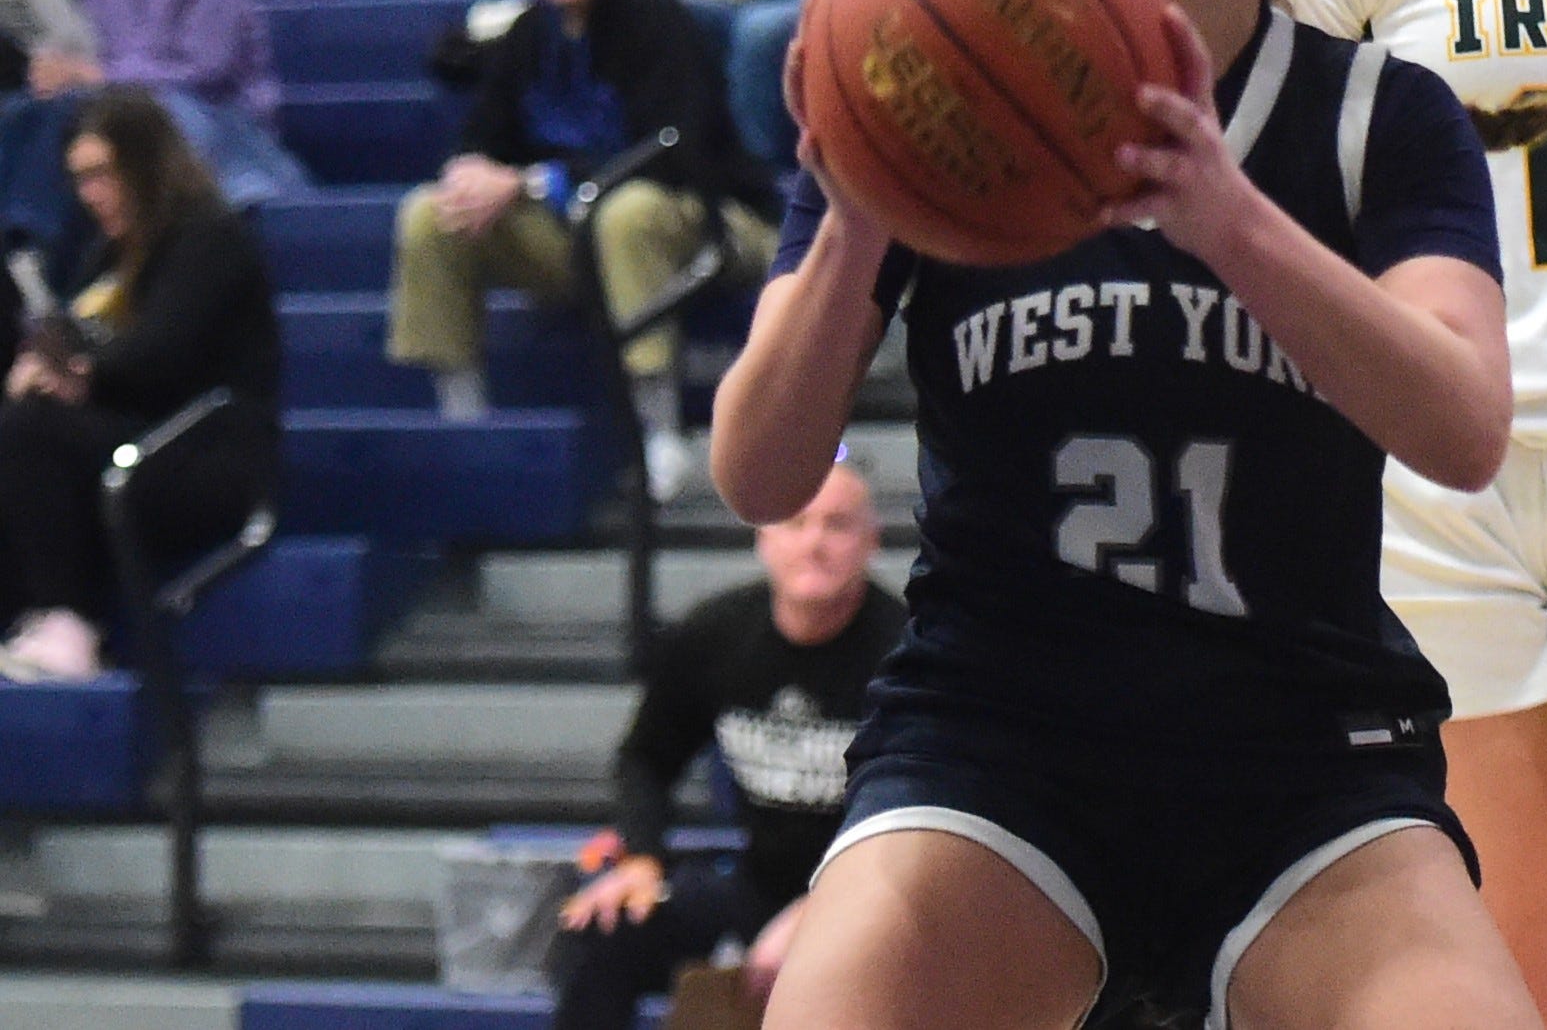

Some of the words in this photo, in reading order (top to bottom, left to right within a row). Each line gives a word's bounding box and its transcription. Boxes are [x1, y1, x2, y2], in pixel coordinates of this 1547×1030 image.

[953, 281, 1150, 394] WEST
[1170, 282, 1329, 403] YO
[1054, 433, 1250, 618] 21
